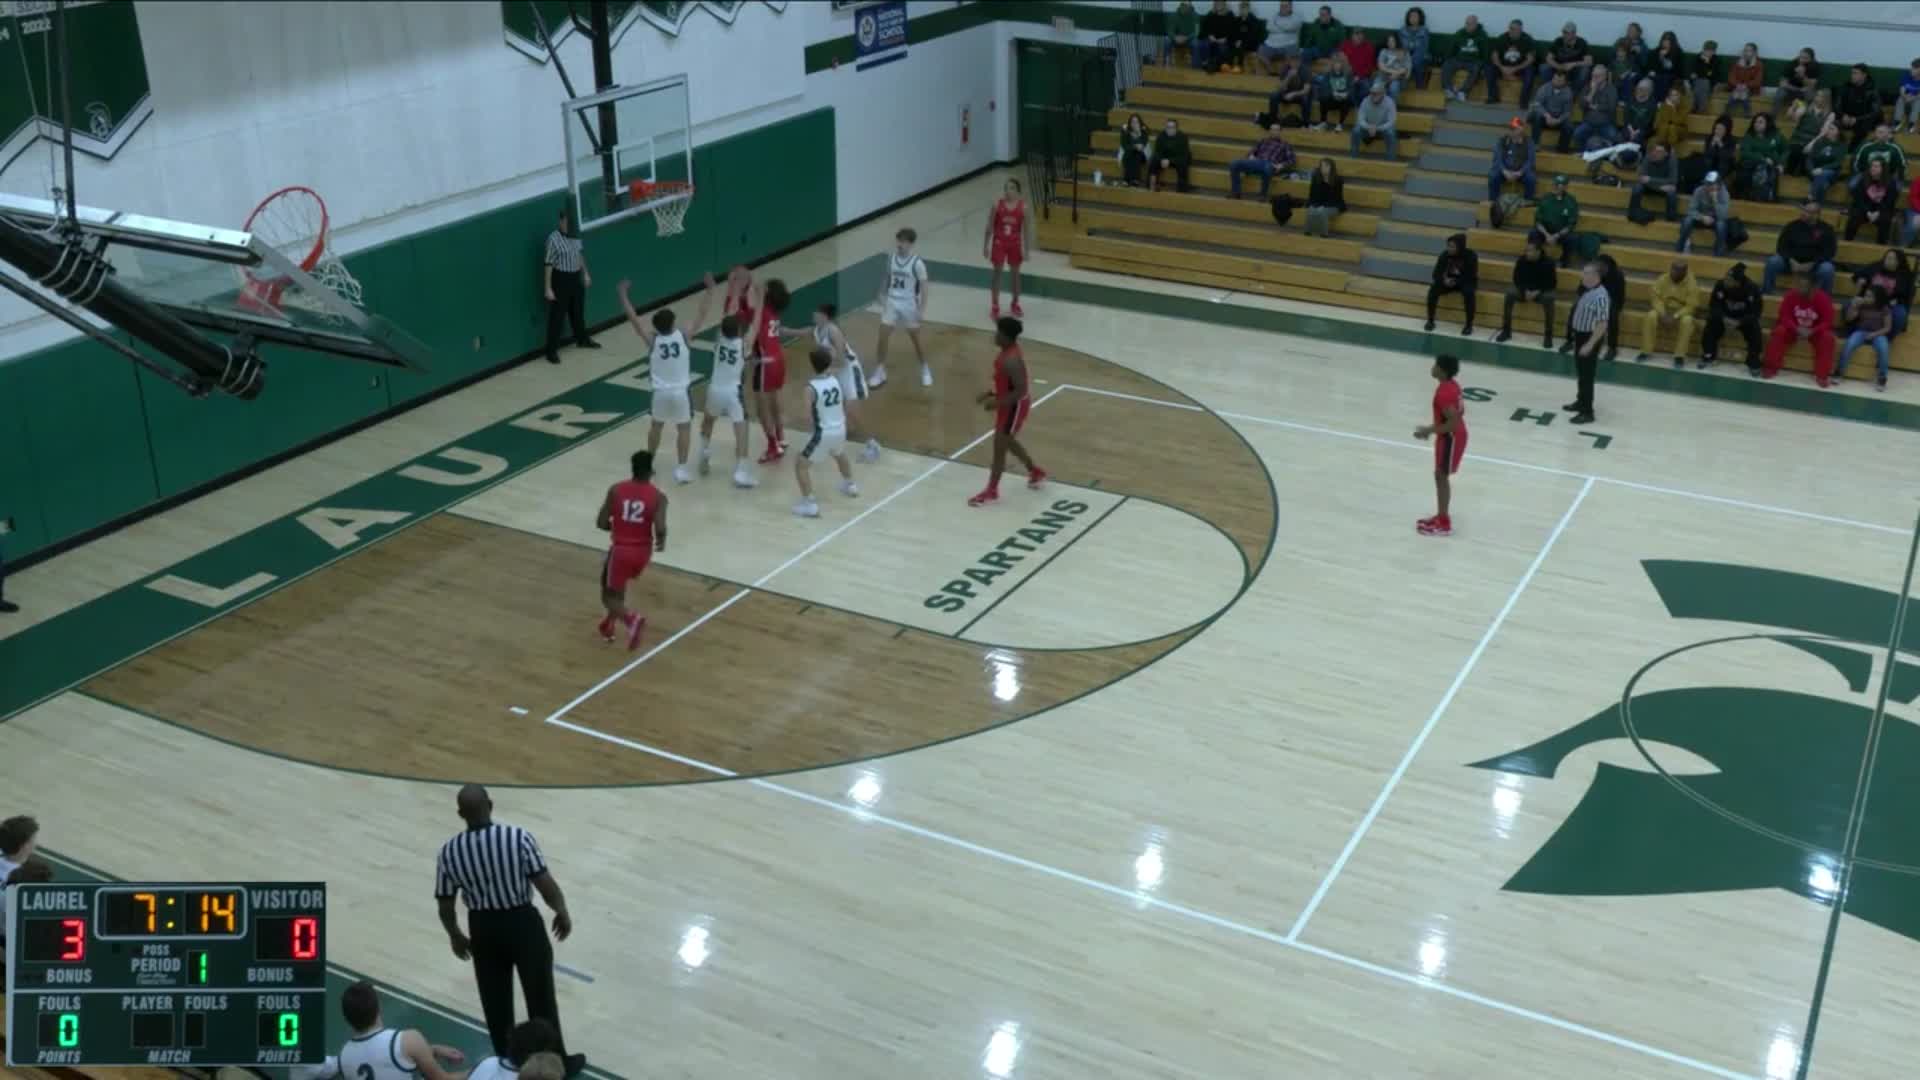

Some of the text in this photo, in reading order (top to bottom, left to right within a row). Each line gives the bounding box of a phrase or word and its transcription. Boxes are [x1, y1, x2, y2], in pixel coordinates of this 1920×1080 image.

[659, 341, 681, 360] 33
[719, 346, 738, 365] 55
[823, 387, 840, 407] 22
[623, 499, 645, 523] 12
[923, 499, 1089, 613] SPARTANS
